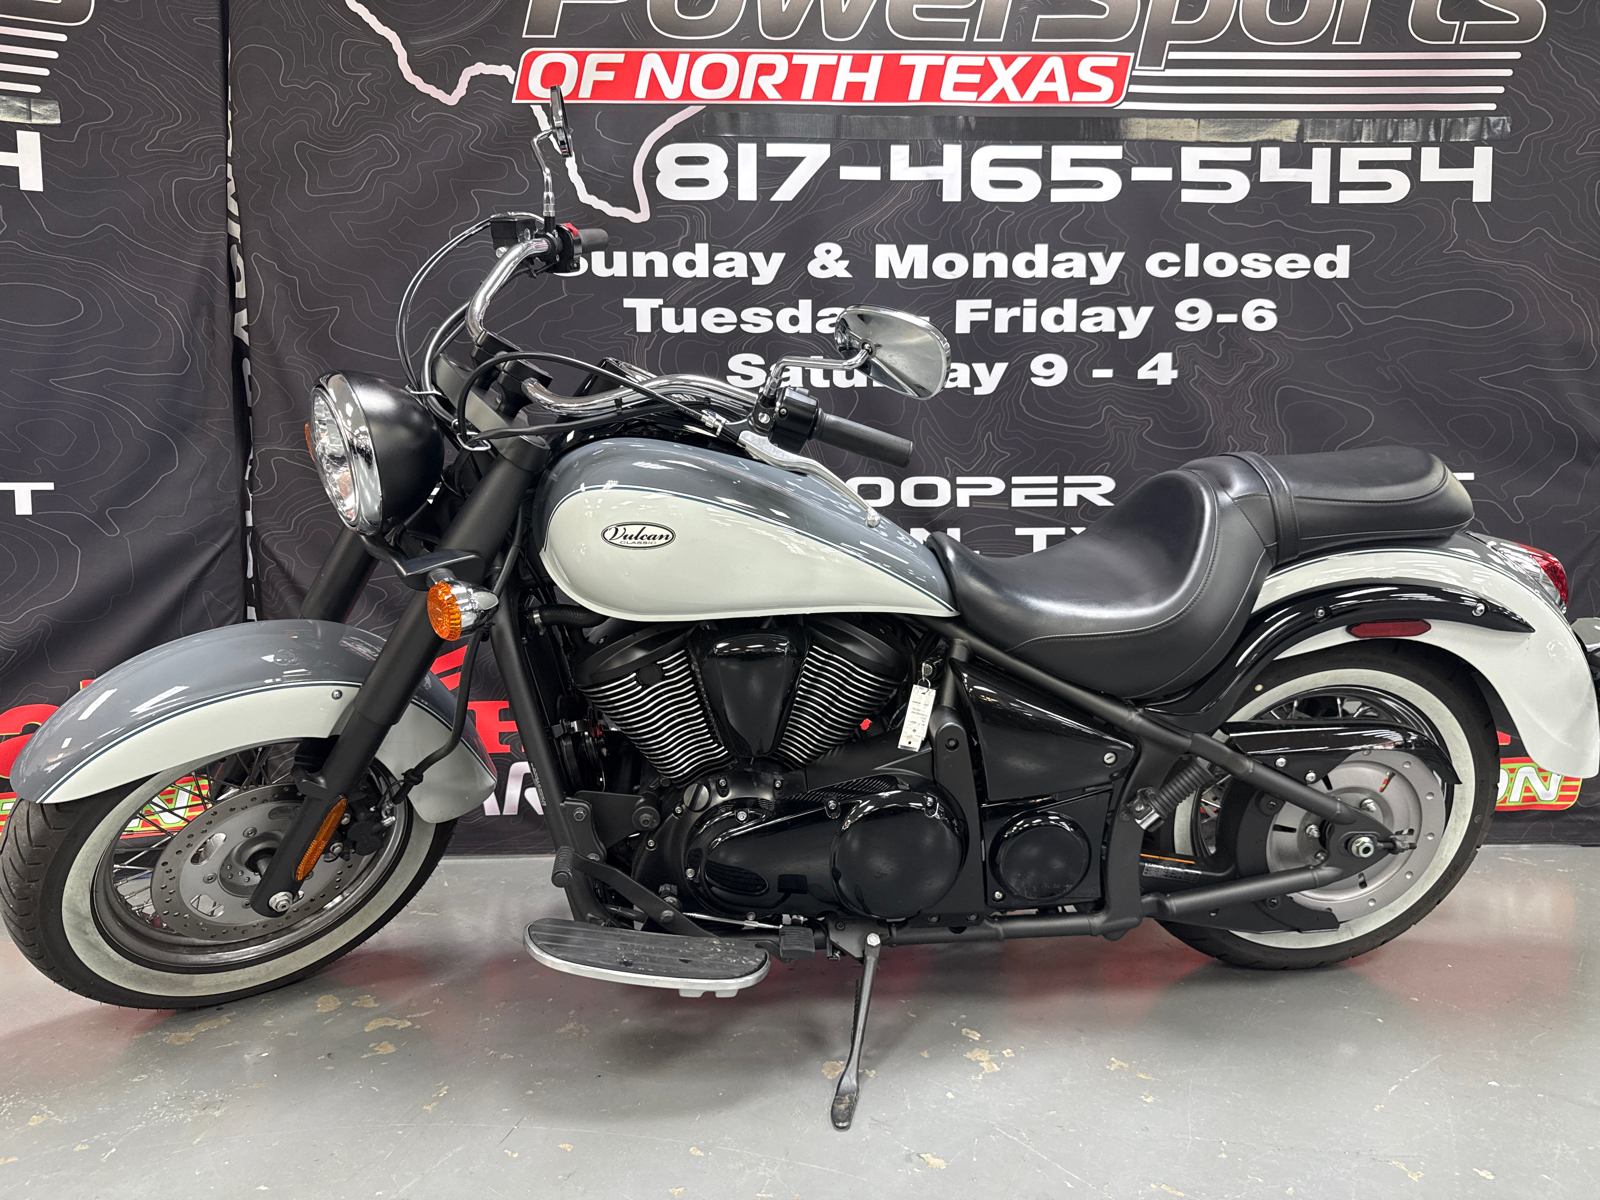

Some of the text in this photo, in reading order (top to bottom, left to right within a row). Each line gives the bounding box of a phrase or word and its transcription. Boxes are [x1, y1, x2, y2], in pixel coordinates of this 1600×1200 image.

[528, 52, 1119, 103] OF NORTH TEXAS
[655, 142, 1494, 204] 817-465-5454
[807, 242, 853, 279] &
[875, 243, 1126, 286] Monday
[1145, 242, 1351, 280] closed
[622, 297, 1278, 340] Tuesda Friday 9-6
[727, 352, 1009, 396] Satuay
[1030, 353, 1068, 387] 9
[1137, 352, 1179, 386] 4
[846, 475, 1117, 508] OOPER
[608, 526, 671, 541] Vulcan
